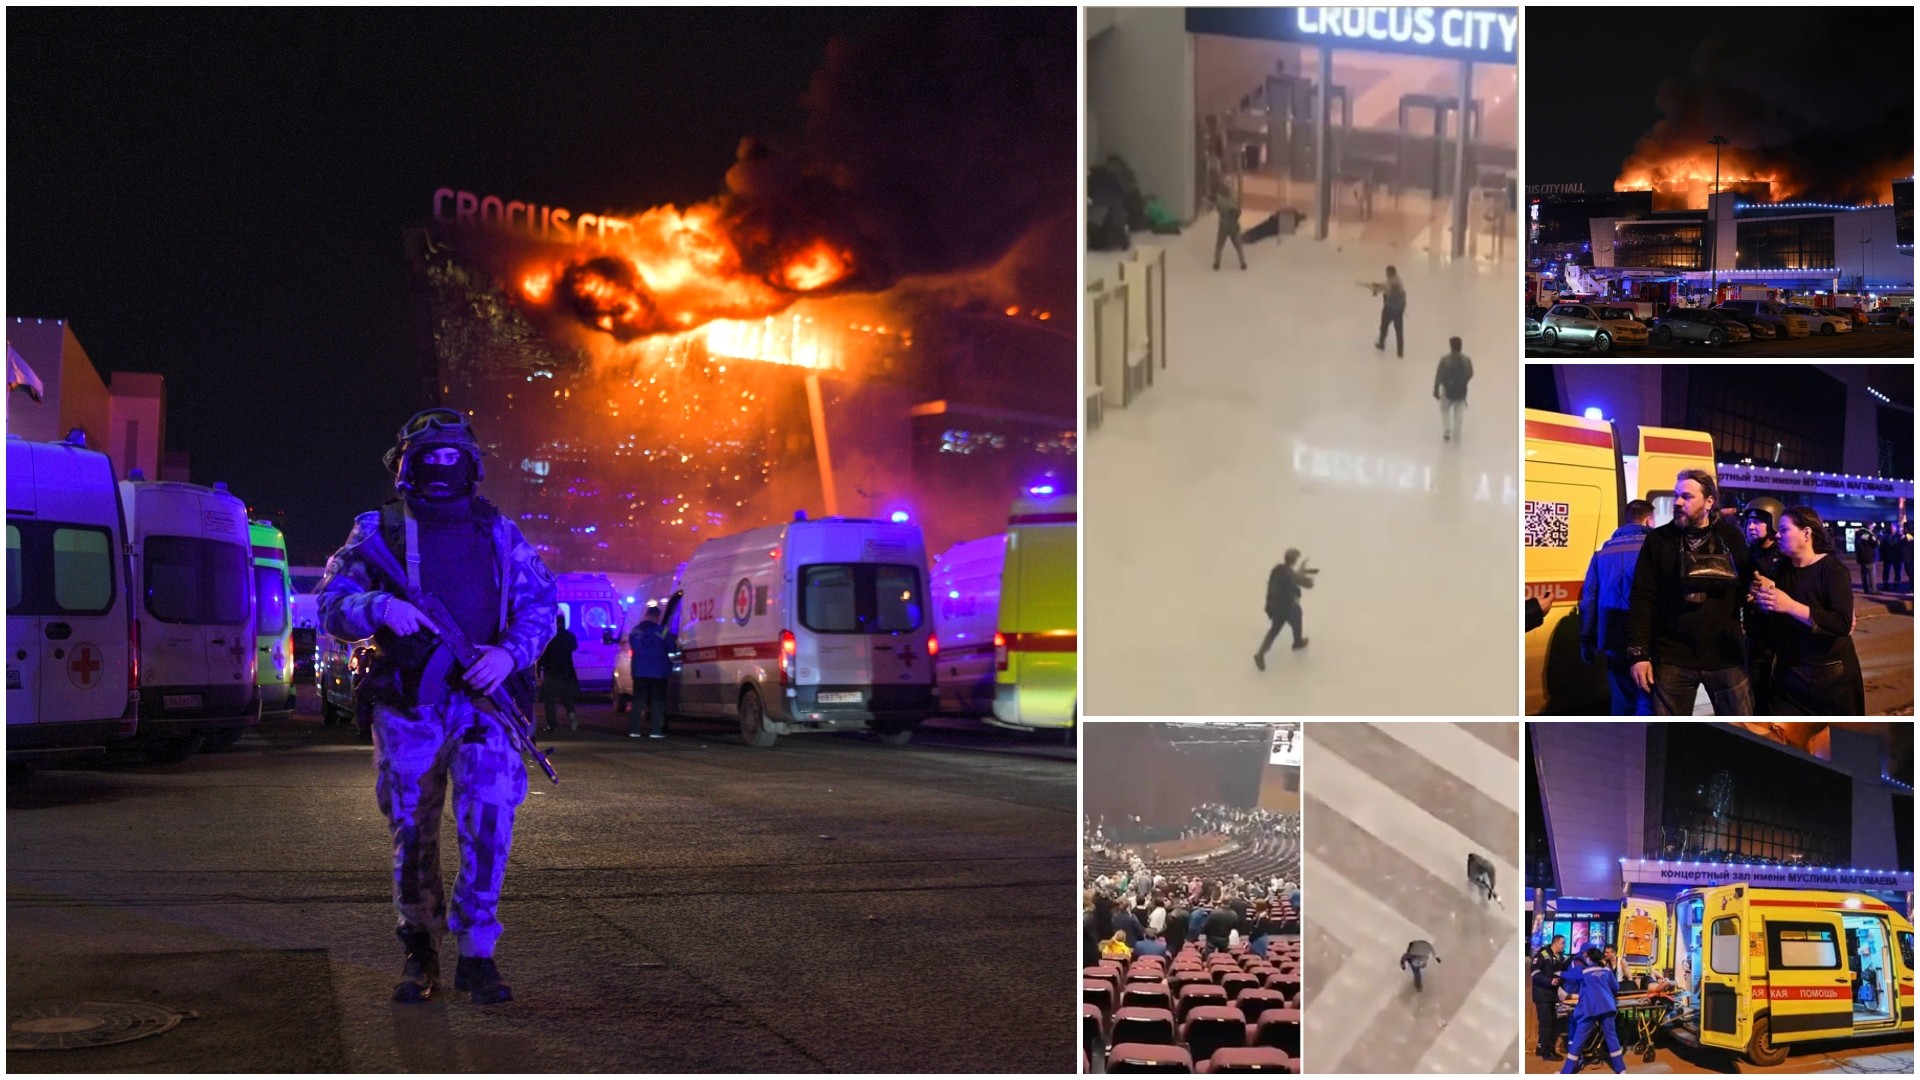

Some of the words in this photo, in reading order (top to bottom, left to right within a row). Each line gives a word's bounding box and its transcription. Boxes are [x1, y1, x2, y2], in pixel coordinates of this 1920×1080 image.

[1297, 7, 1436, 45] CROCUS
[1441, 8, 1517, 53] CITY
[1541, 184, 1560, 194] CITY
[433, 187, 571, 244] CROCUS
[1753, 475, 1770, 484] зал
[1661, 870, 1729, 881] концертный
[1732, 872, 1750, 880] зал
[1753, 873, 1785, 881] имени
[1788, 873, 1838, 883] МУСЛИМА
[1840, 875, 1898, 886] МАГОМАЕВА
[1800, 989, 1838, 998] ПОМОЩЬ
